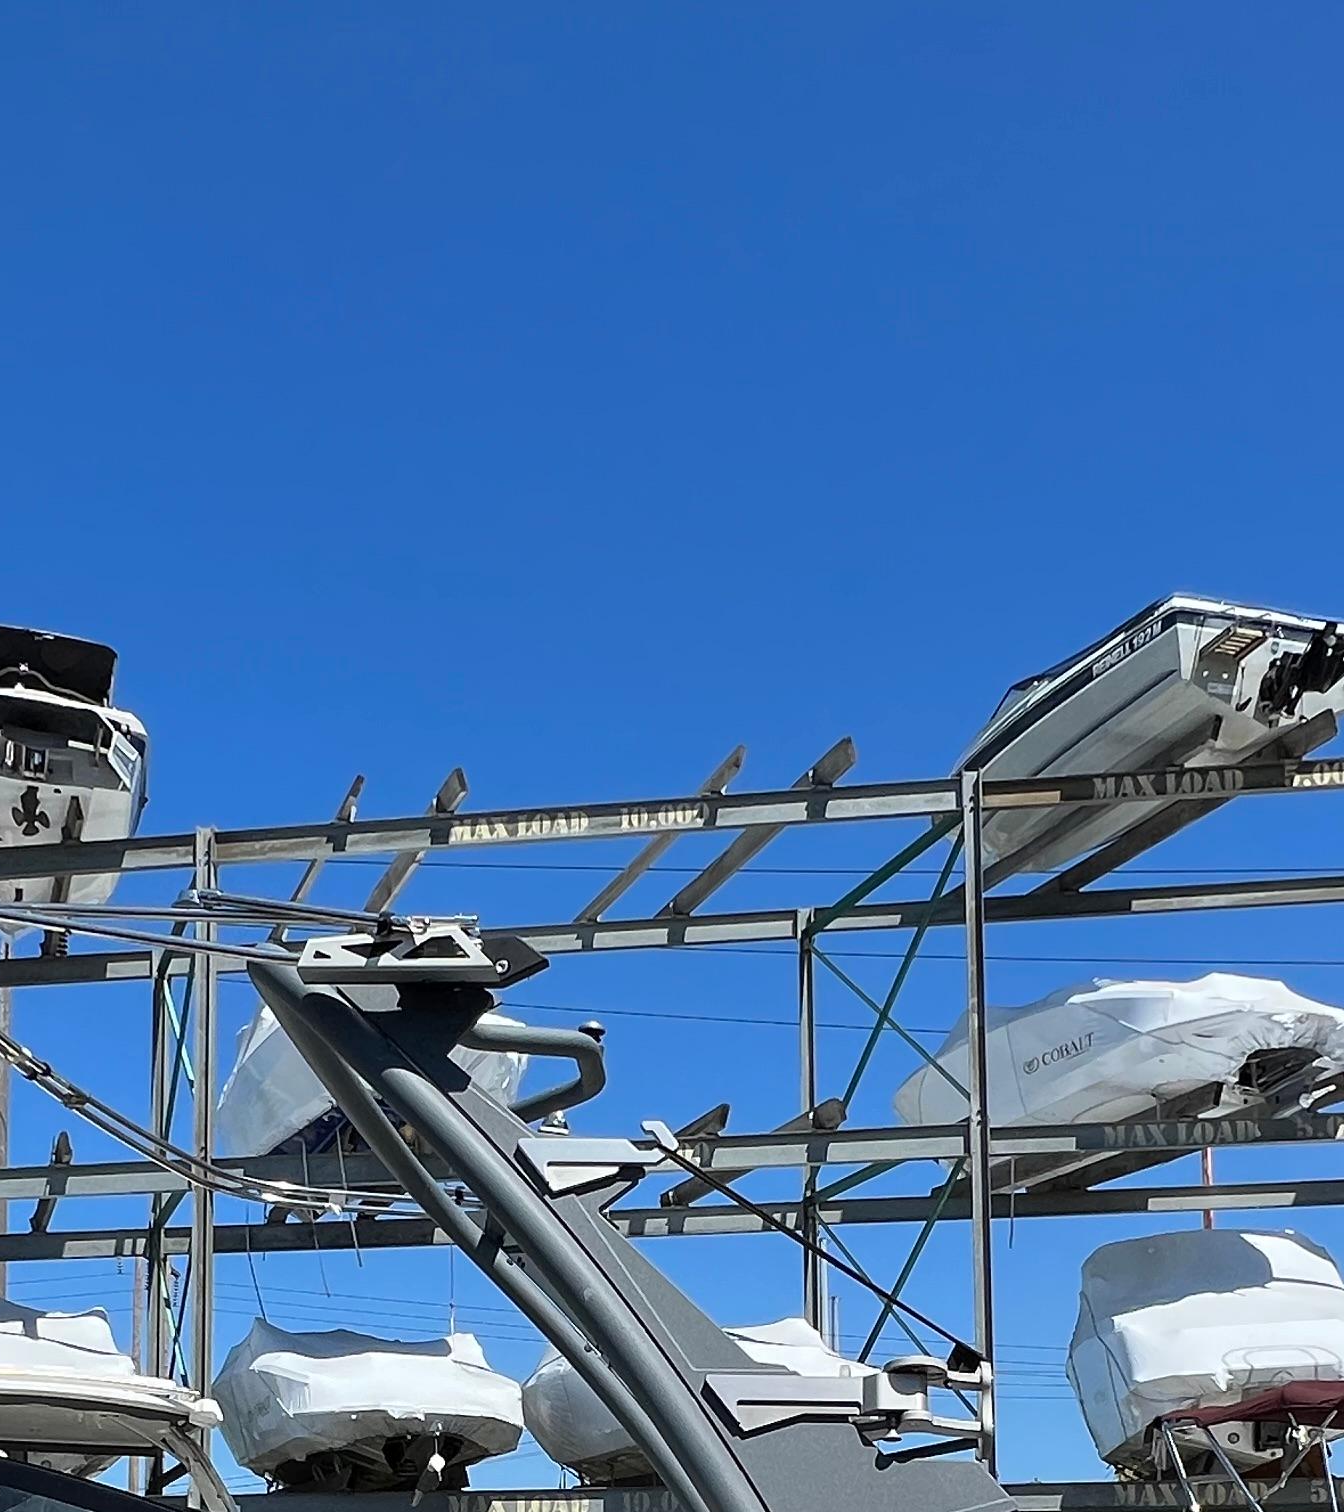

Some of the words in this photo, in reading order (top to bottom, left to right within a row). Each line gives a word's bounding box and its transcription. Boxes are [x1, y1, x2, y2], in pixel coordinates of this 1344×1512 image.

[1092, 774, 1158, 800] MAX
[1165, 767, 1245, 795] LOAD
[452, 817, 512, 843] MAX
[517, 811, 591, 838] LOAD
[1041, 1032, 1095, 1067] COBALT
[1105, 1122, 1169, 1147] MAX
[1177, 1119, 1261, 1145] LOAD
[1113, 1483, 1177, 1507] MAX
